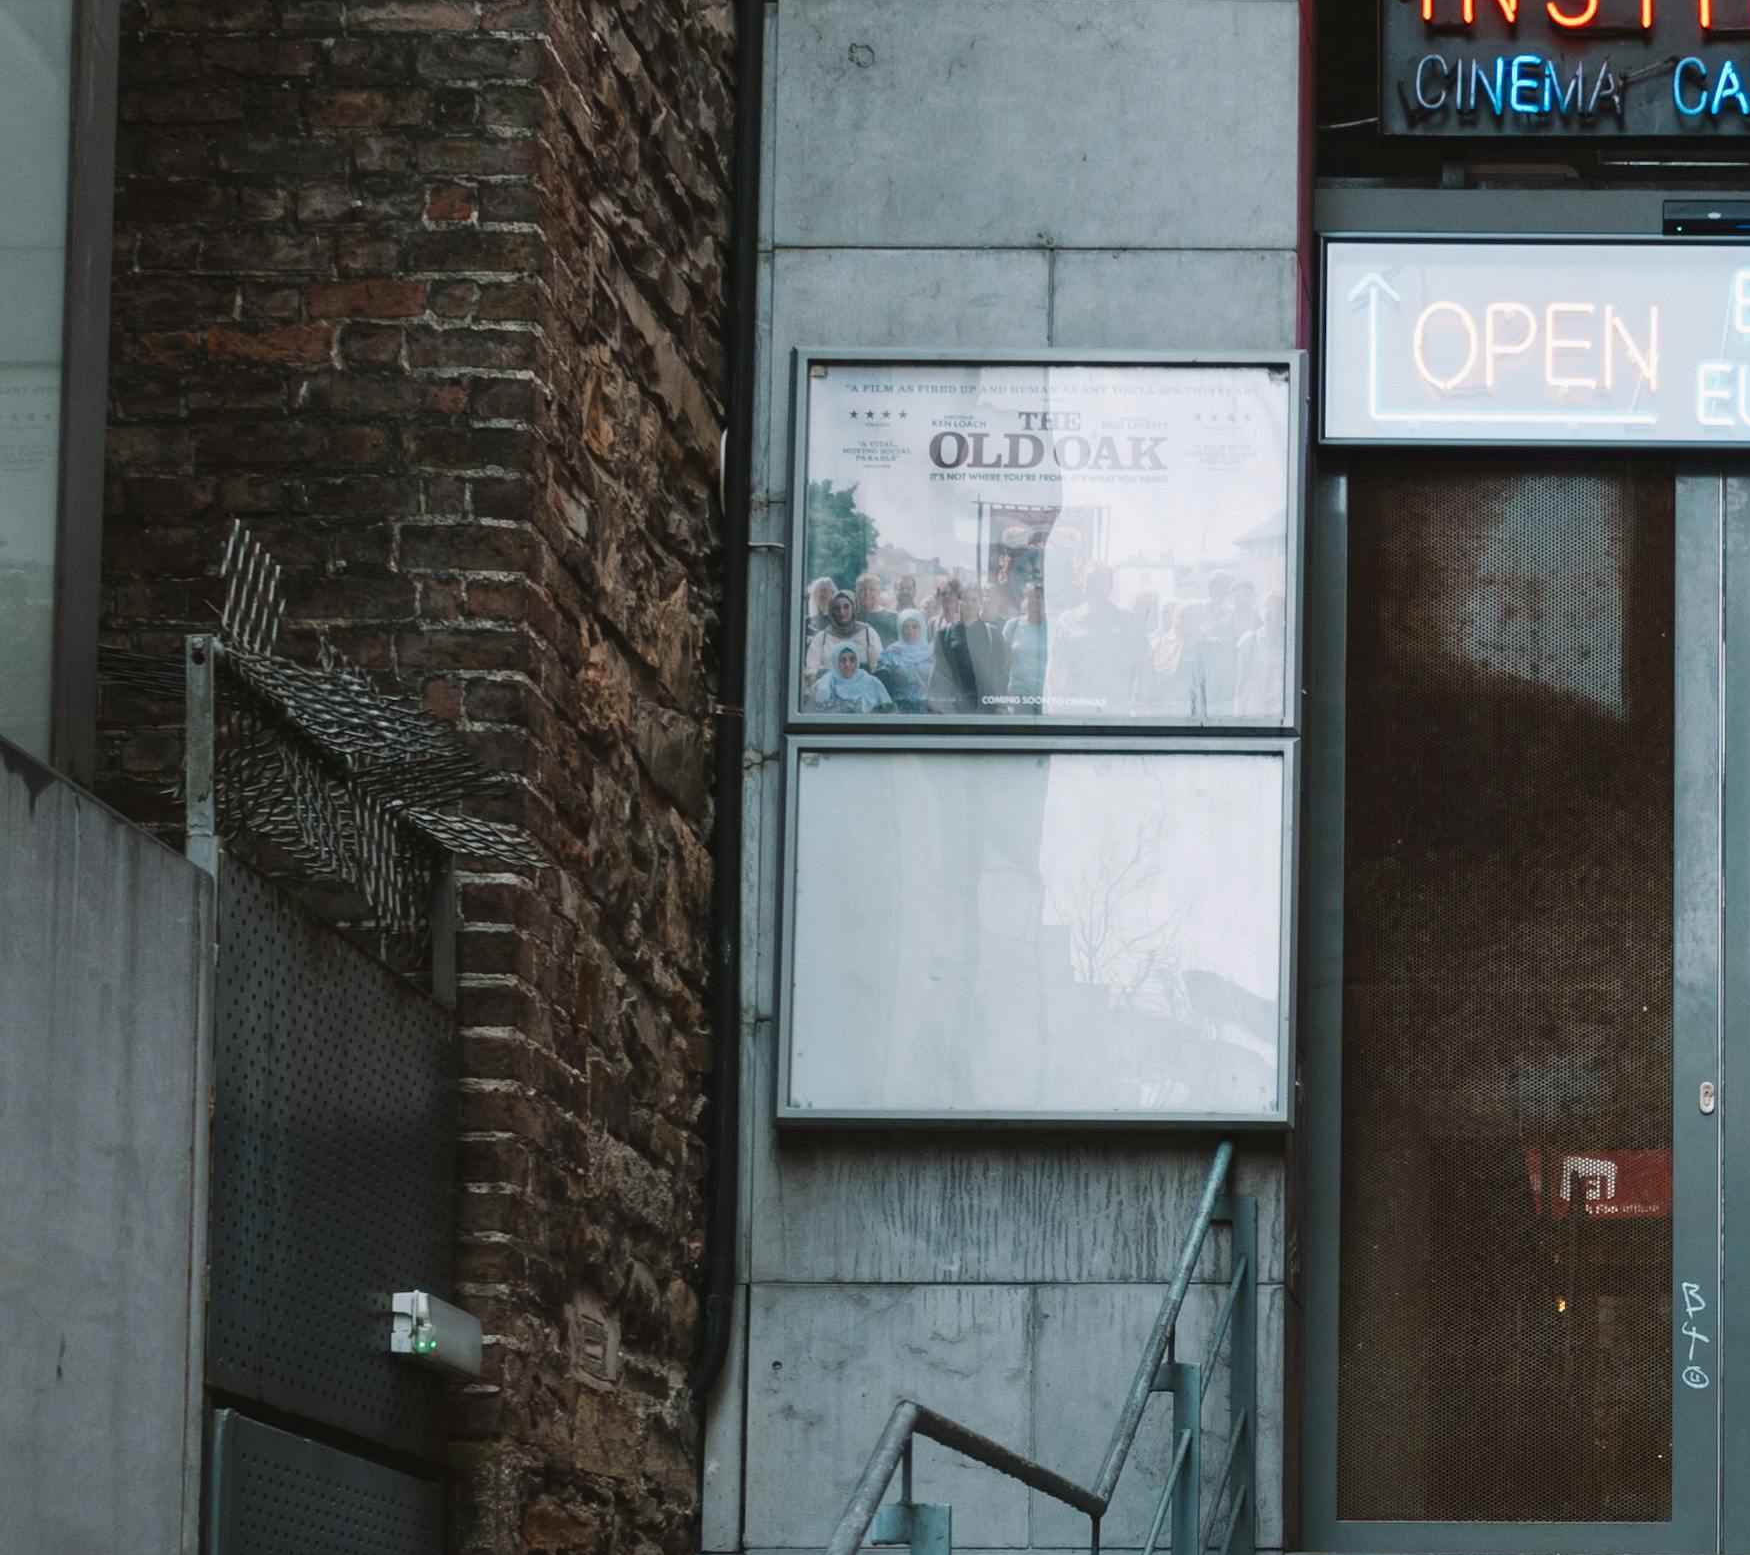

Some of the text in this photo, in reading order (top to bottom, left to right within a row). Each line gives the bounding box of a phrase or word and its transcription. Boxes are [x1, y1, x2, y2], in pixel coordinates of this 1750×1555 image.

[1413, 52, 1624, 116] CINEMA
[1413, 301, 1660, 391] OPEN
[863, 384, 894, 393] FILM
[898, 385, 914, 394] AS
[918, 385, 957, 394] FIRED
[960, 385, 976, 394] UP
[981, 385, 1007, 395] AND
[1010, 385, 1058, 395] HUMAN
[932, 419, 987, 429] KEN LOACH
[1018, 411, 1081, 432] THE
[1102, 421, 1124, 430] PAUL
[929, 431, 1045, 469] OLD
[1053, 434, 1168, 471] OAK
[946, 473, 967, 481] NOT
[968, 473, 1000, 481] WHERE
[982, 695, 1020, 705] COMING
[1022, 696, 1050, 705] SOON
[1065, 697, 1106, 707] CINEMAS
